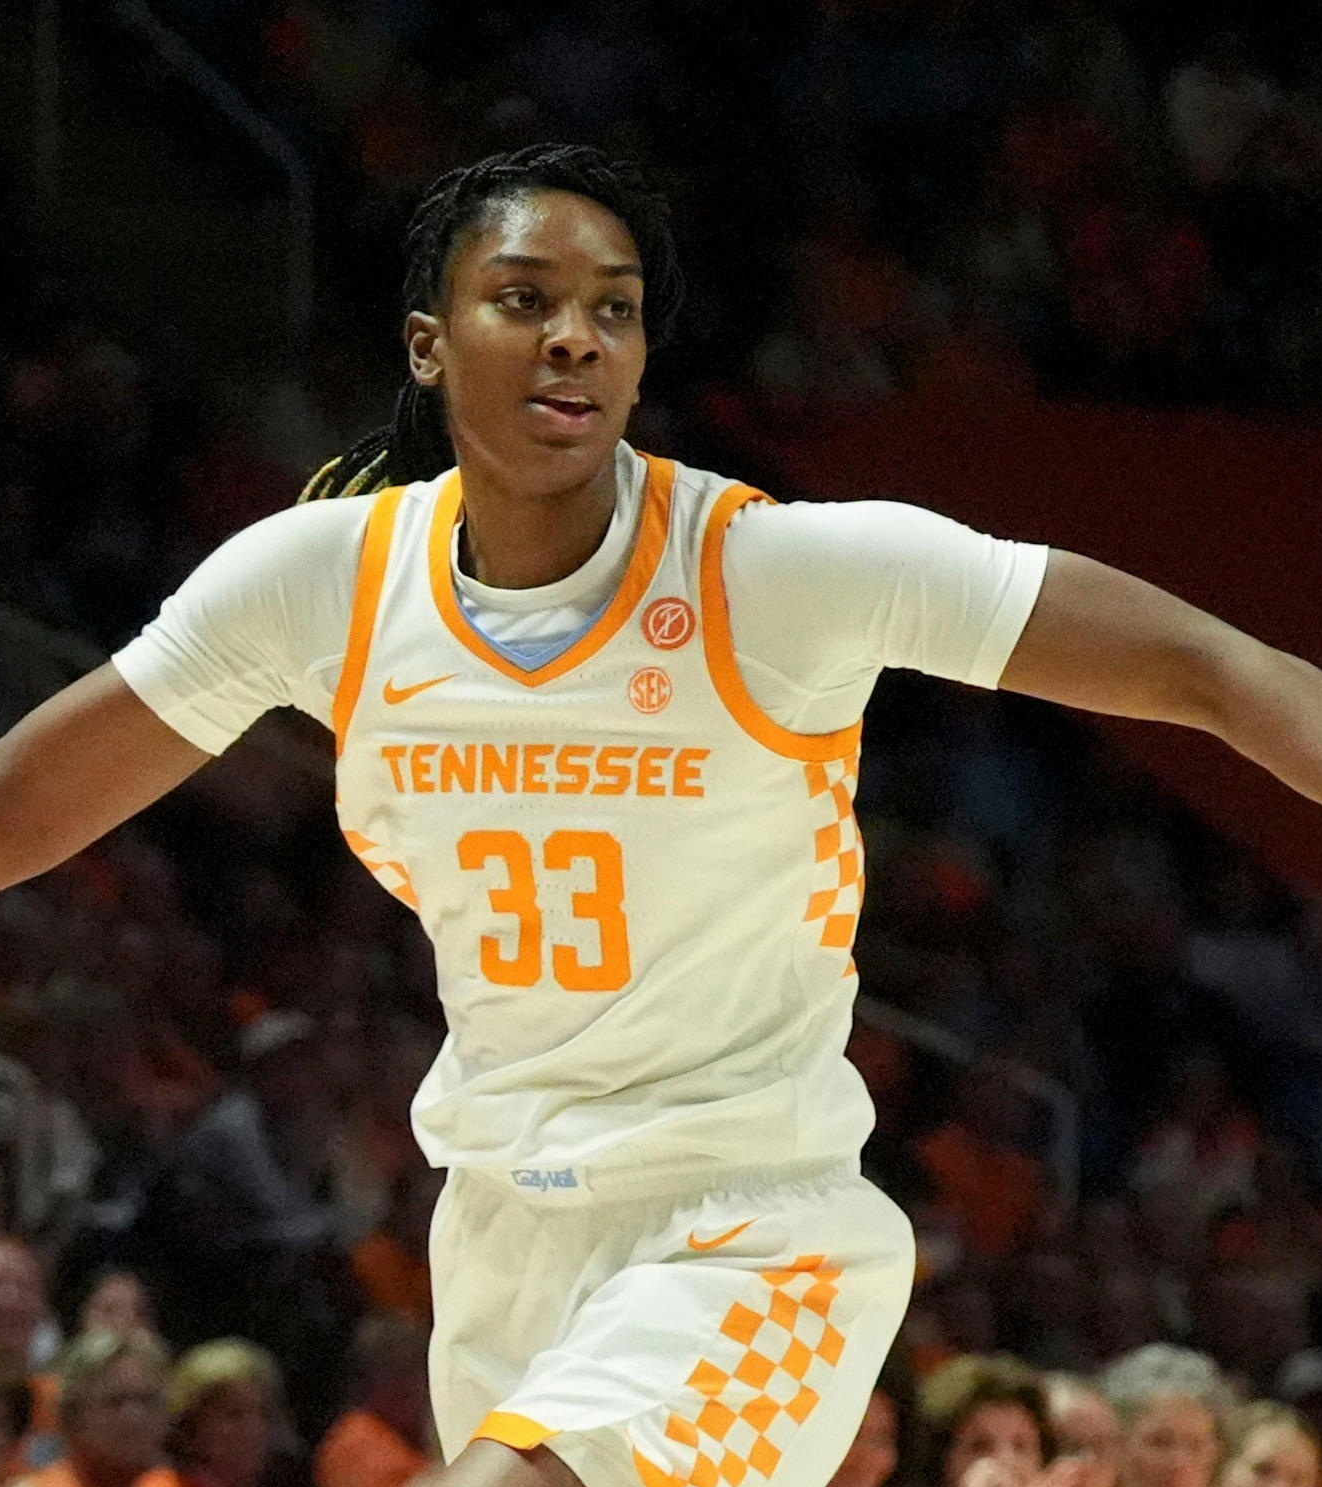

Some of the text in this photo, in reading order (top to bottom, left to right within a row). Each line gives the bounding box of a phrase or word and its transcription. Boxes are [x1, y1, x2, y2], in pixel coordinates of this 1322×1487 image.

[630, 671, 672, 710] SEC
[381, 743, 711, 798] TENNESSEE
[456, 829, 631, 992] 33
